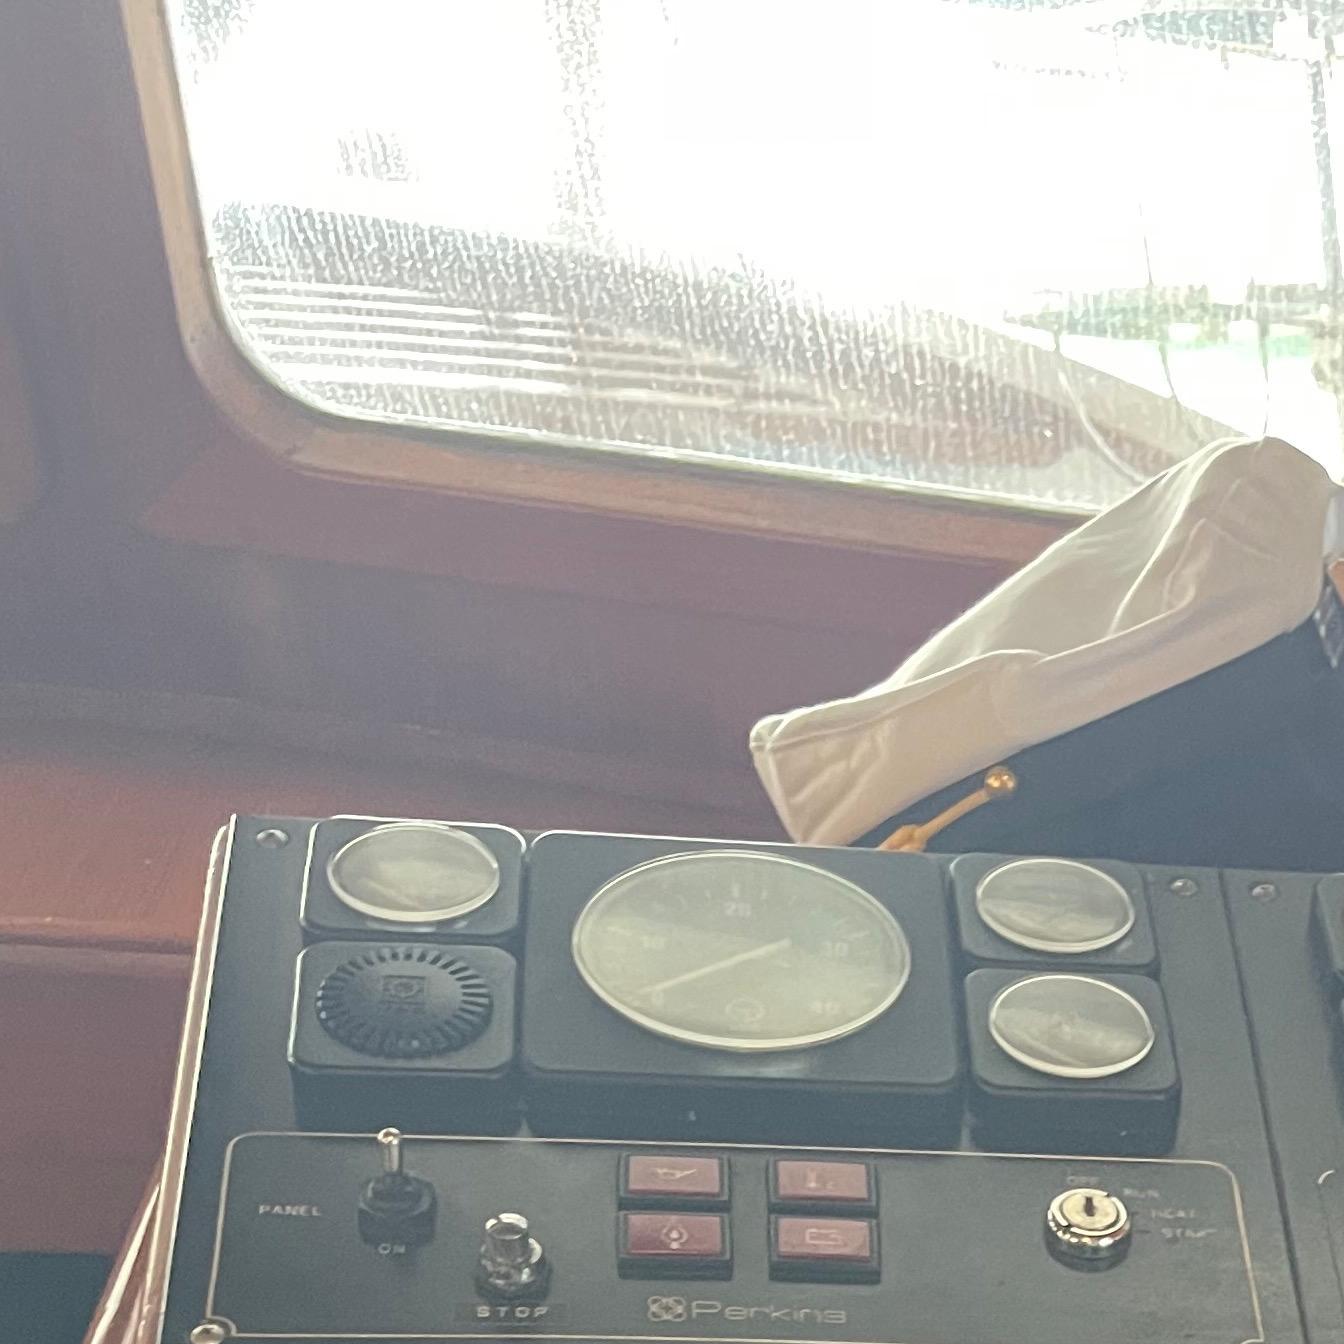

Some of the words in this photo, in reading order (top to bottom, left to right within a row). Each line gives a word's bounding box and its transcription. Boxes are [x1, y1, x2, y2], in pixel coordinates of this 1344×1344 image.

[258, 1204, 322, 1217] PANEL
[377, 1243, 406, 1255] ON
[476, 1306, 549, 1318] STOP
[691, 1299, 847, 1324] Perkins
